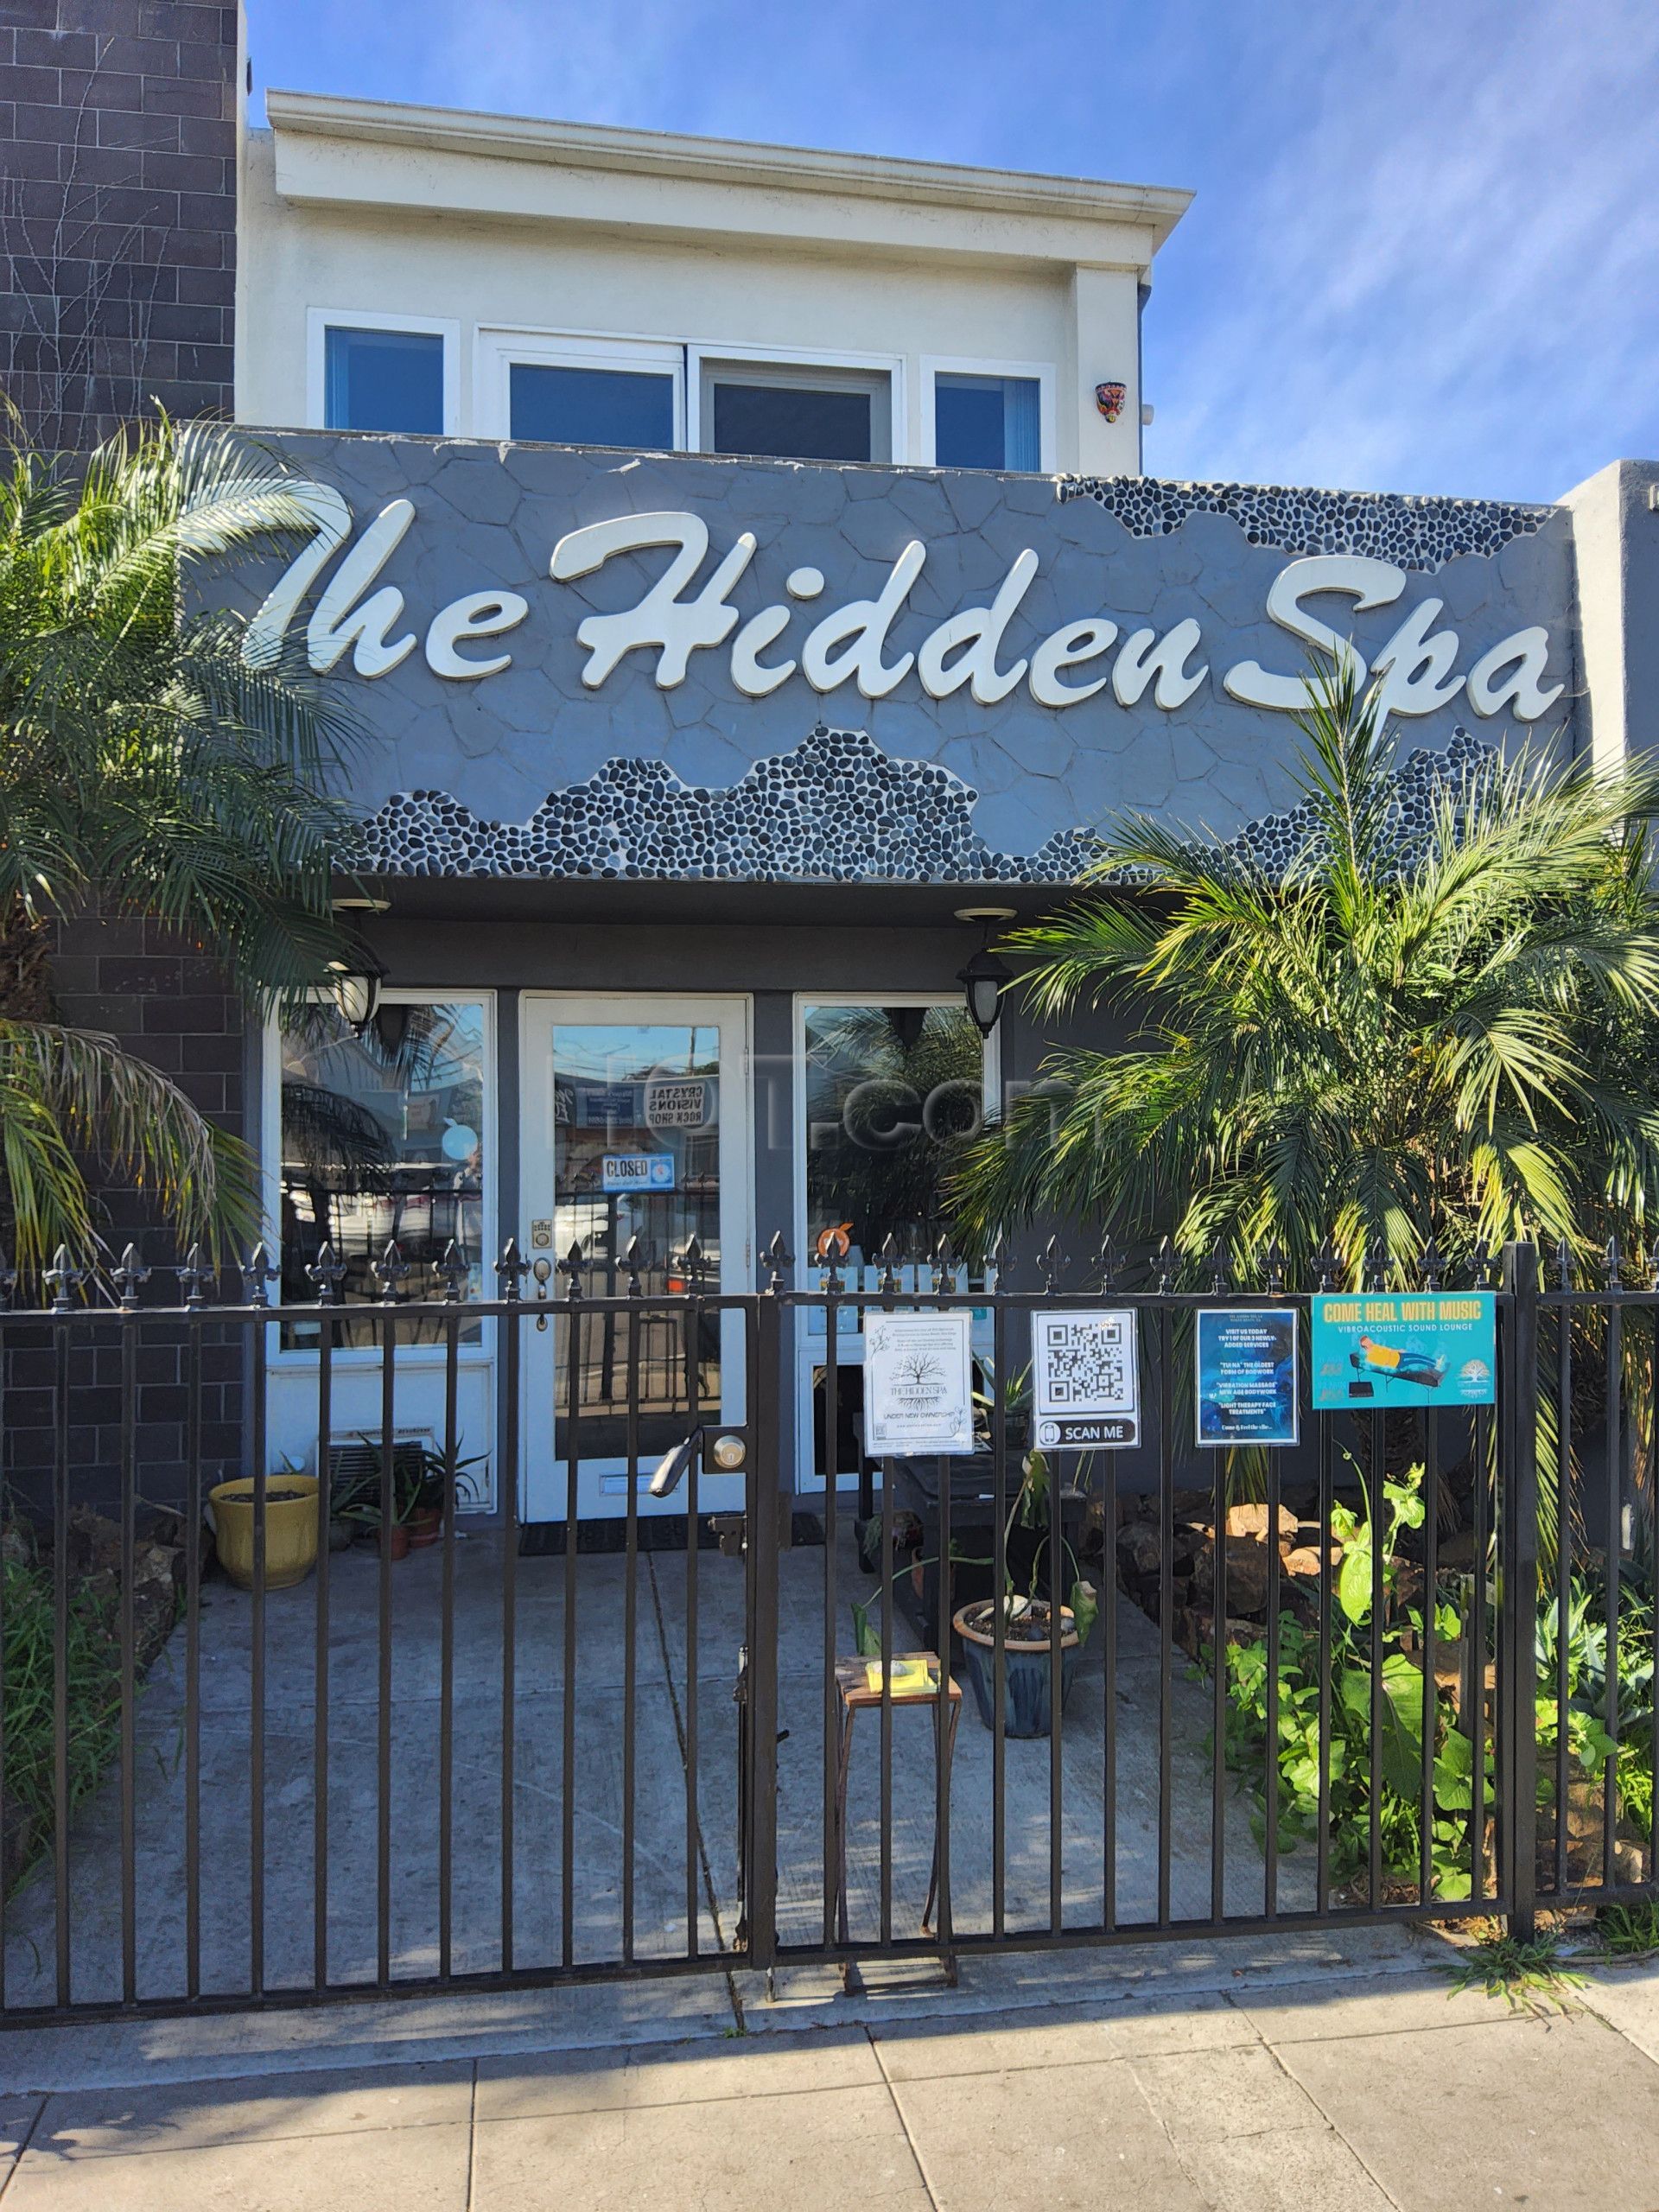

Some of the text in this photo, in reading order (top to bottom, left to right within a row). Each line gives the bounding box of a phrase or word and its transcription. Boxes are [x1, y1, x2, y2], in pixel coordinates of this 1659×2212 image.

[177, 479, 1565, 757] The Hidden Spa
[607, 1160, 647, 1177] CLOSED
[1324, 1300, 1482, 1322] COME HEAL WITH MUSIC
[1338, 1323, 1473, 1333] VIBROACOUSTIC SOUND LOUNGE
[1065, 1426, 1124, 1440] SCAN ME
